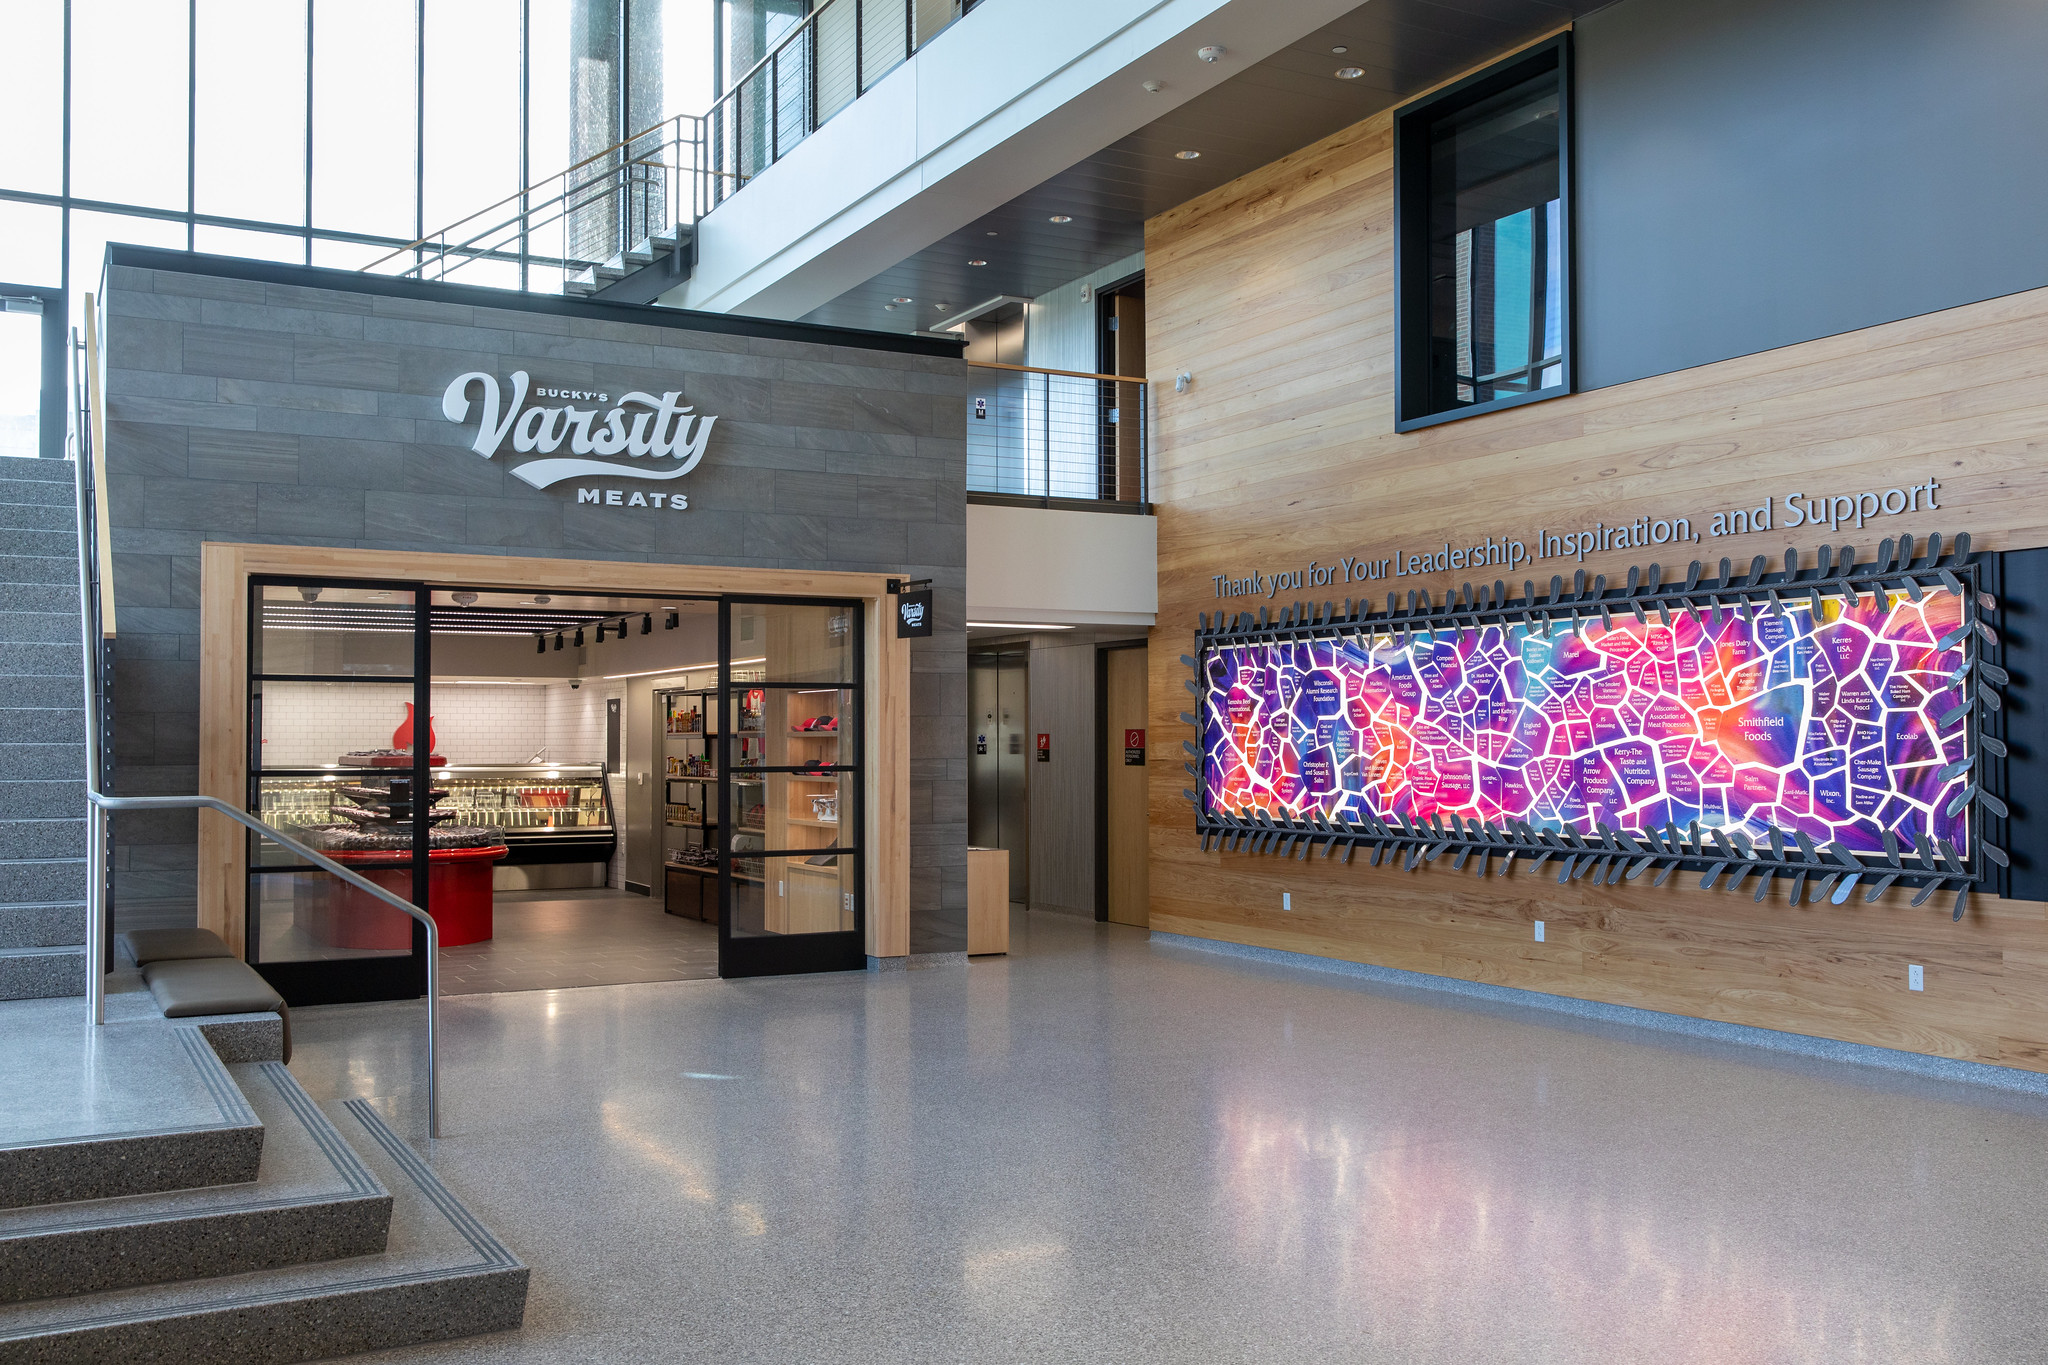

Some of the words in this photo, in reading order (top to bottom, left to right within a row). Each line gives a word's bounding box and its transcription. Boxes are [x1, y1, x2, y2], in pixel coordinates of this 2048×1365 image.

[536, 388, 608, 402] BUCKY'S
[442, 370, 718, 490] Varsity
[578, 488, 688, 510] MEATS
[1212, 570, 1264, 598] Thank
[1268, 572, 1303, 599] you
[1308, 561, 1337, 587] for
[1340, 556, 1390, 583] Your
[1396, 536, 1532, 576] Leadership,
[1538, 516, 1700, 562] Inspiration,
[1710, 496, 1774, 537] and
[1784, 477, 1940, 532] Support
[1738, 717, 1784, 726] Smithfield
[1744, 732, 1772, 741] Foods
[1626, 777, 1655, 786] Company
[1586, 786, 1615, 794] Company,
